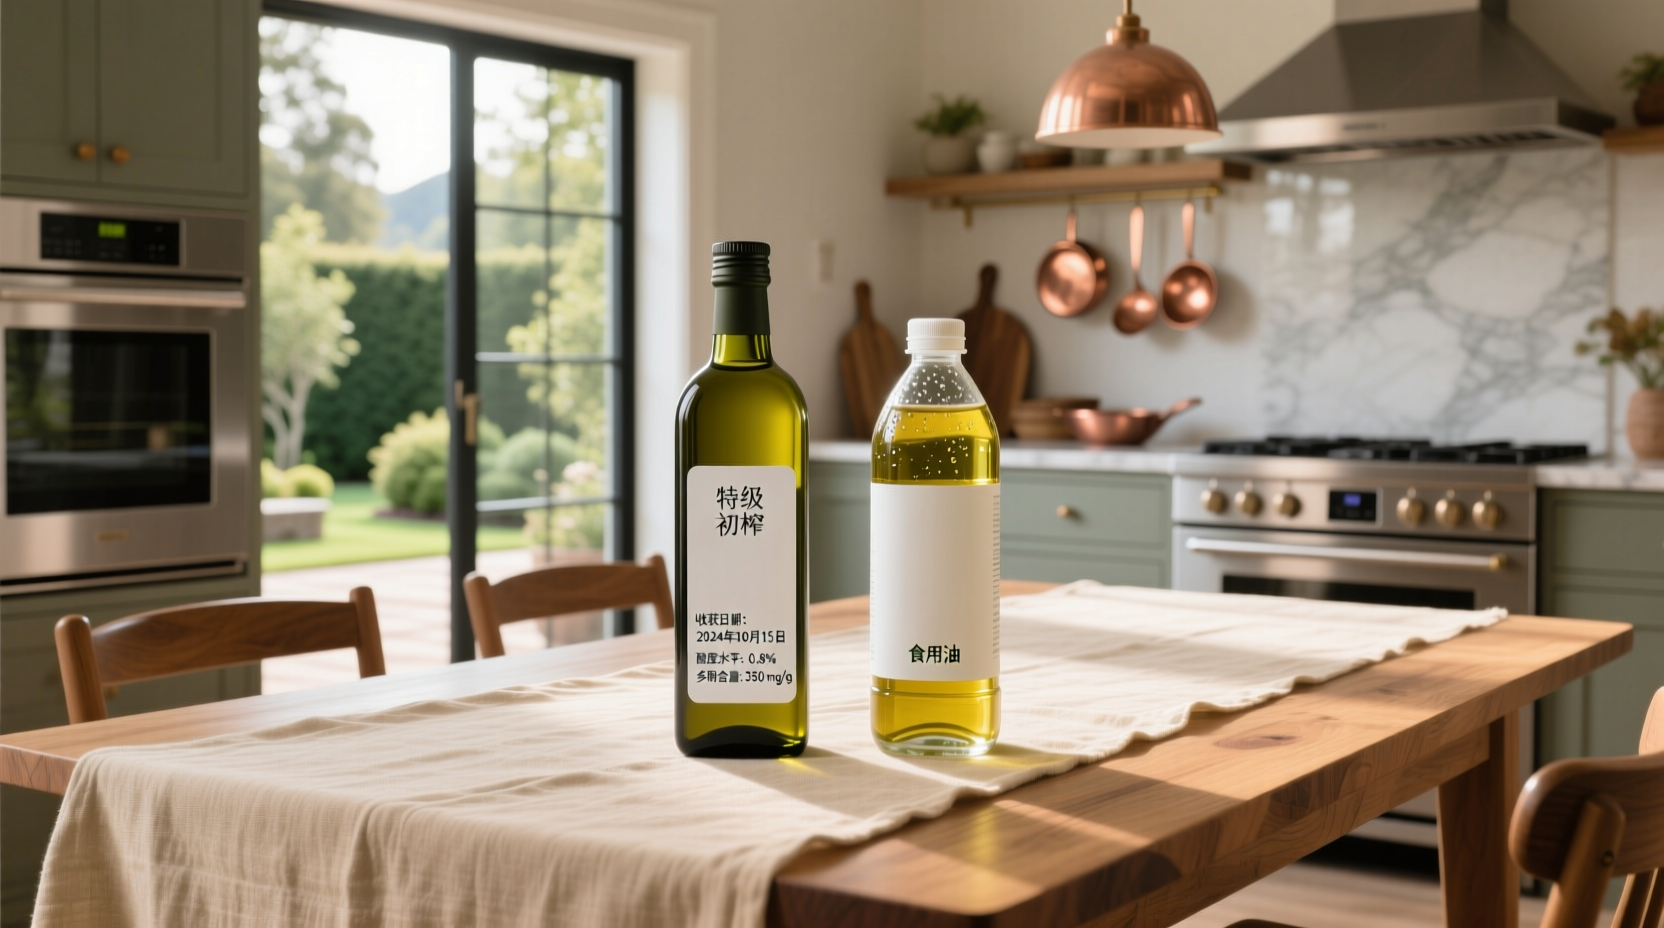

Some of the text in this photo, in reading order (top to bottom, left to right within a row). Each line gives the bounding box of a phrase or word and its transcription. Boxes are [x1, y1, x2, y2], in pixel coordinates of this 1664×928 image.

[716, 484, 764, 510] 特级
[715, 511, 765, 538] 初榨
[696, 629, 786, 645] 2024年10月15日
[908, 643, 961, 665] 食用油
